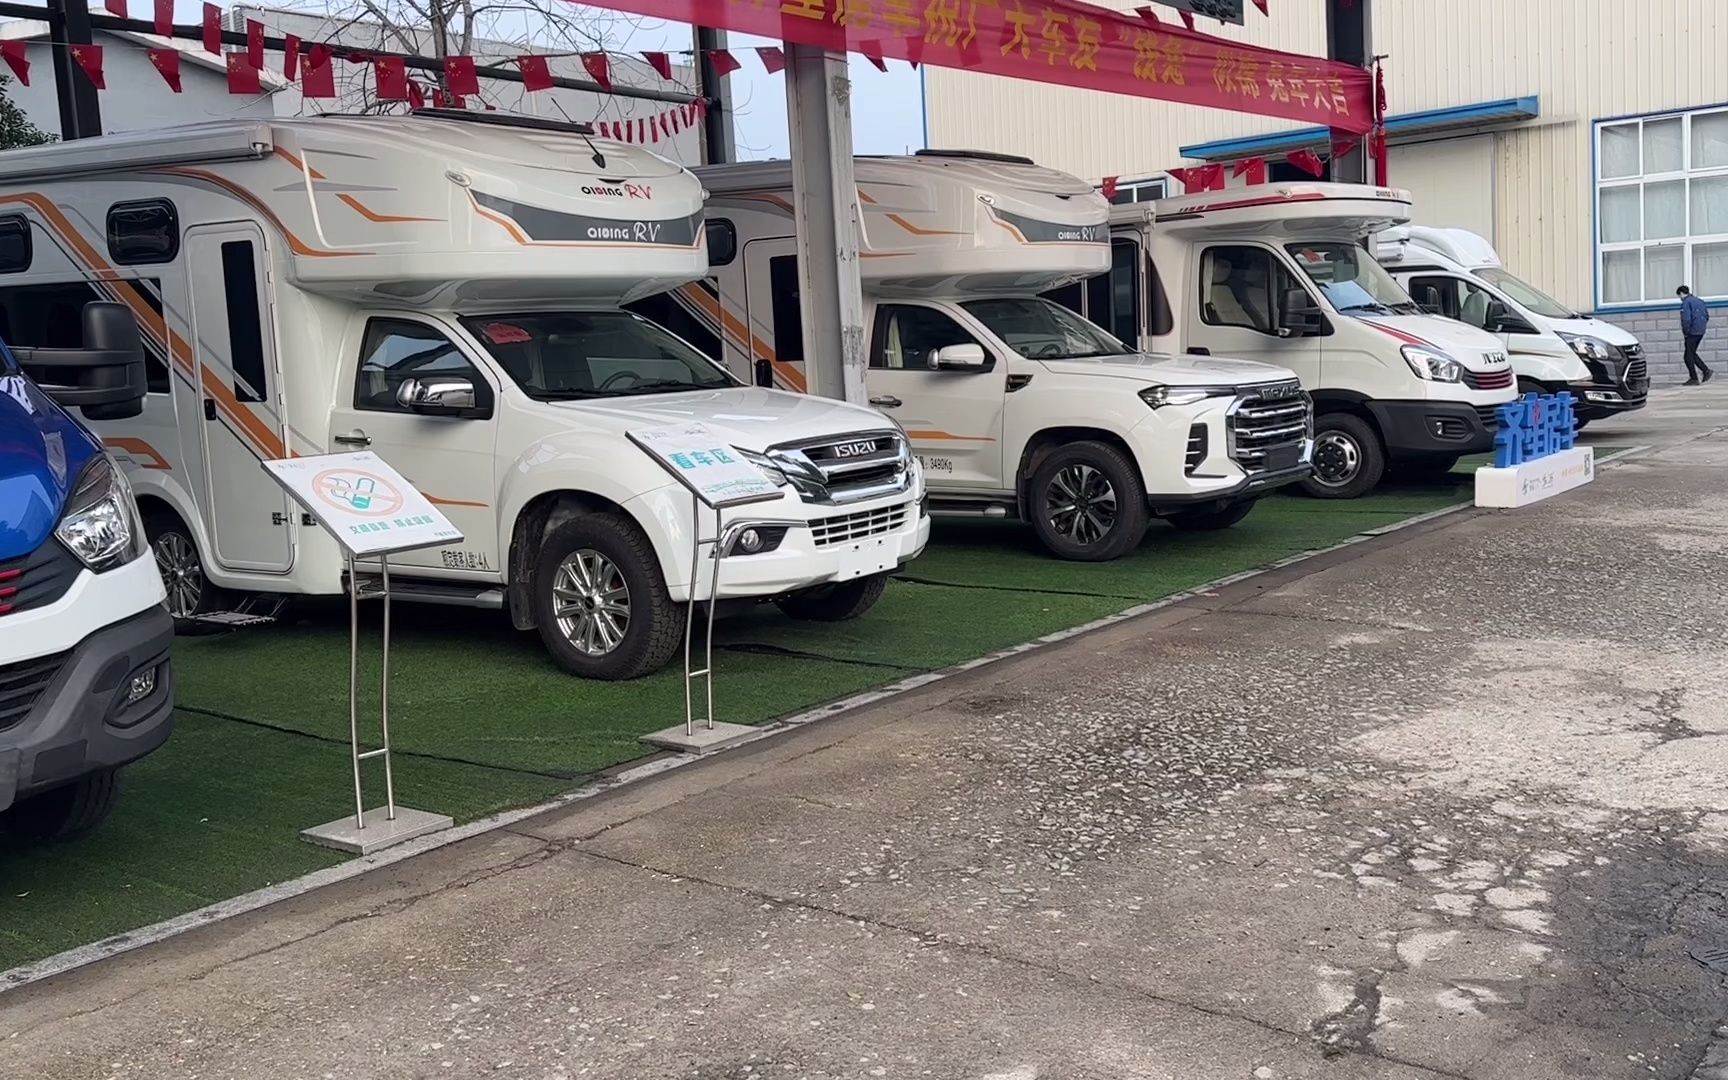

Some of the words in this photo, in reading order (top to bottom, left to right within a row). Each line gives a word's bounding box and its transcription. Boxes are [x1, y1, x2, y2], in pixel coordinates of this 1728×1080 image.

[624, 183, 652, 200] RV
[633, 222, 660, 242] RV
[1081, 226, 1095, 241] RV
[834, 441, 876, 458] ISUZU
[668, 448, 735, 469] 看车区
